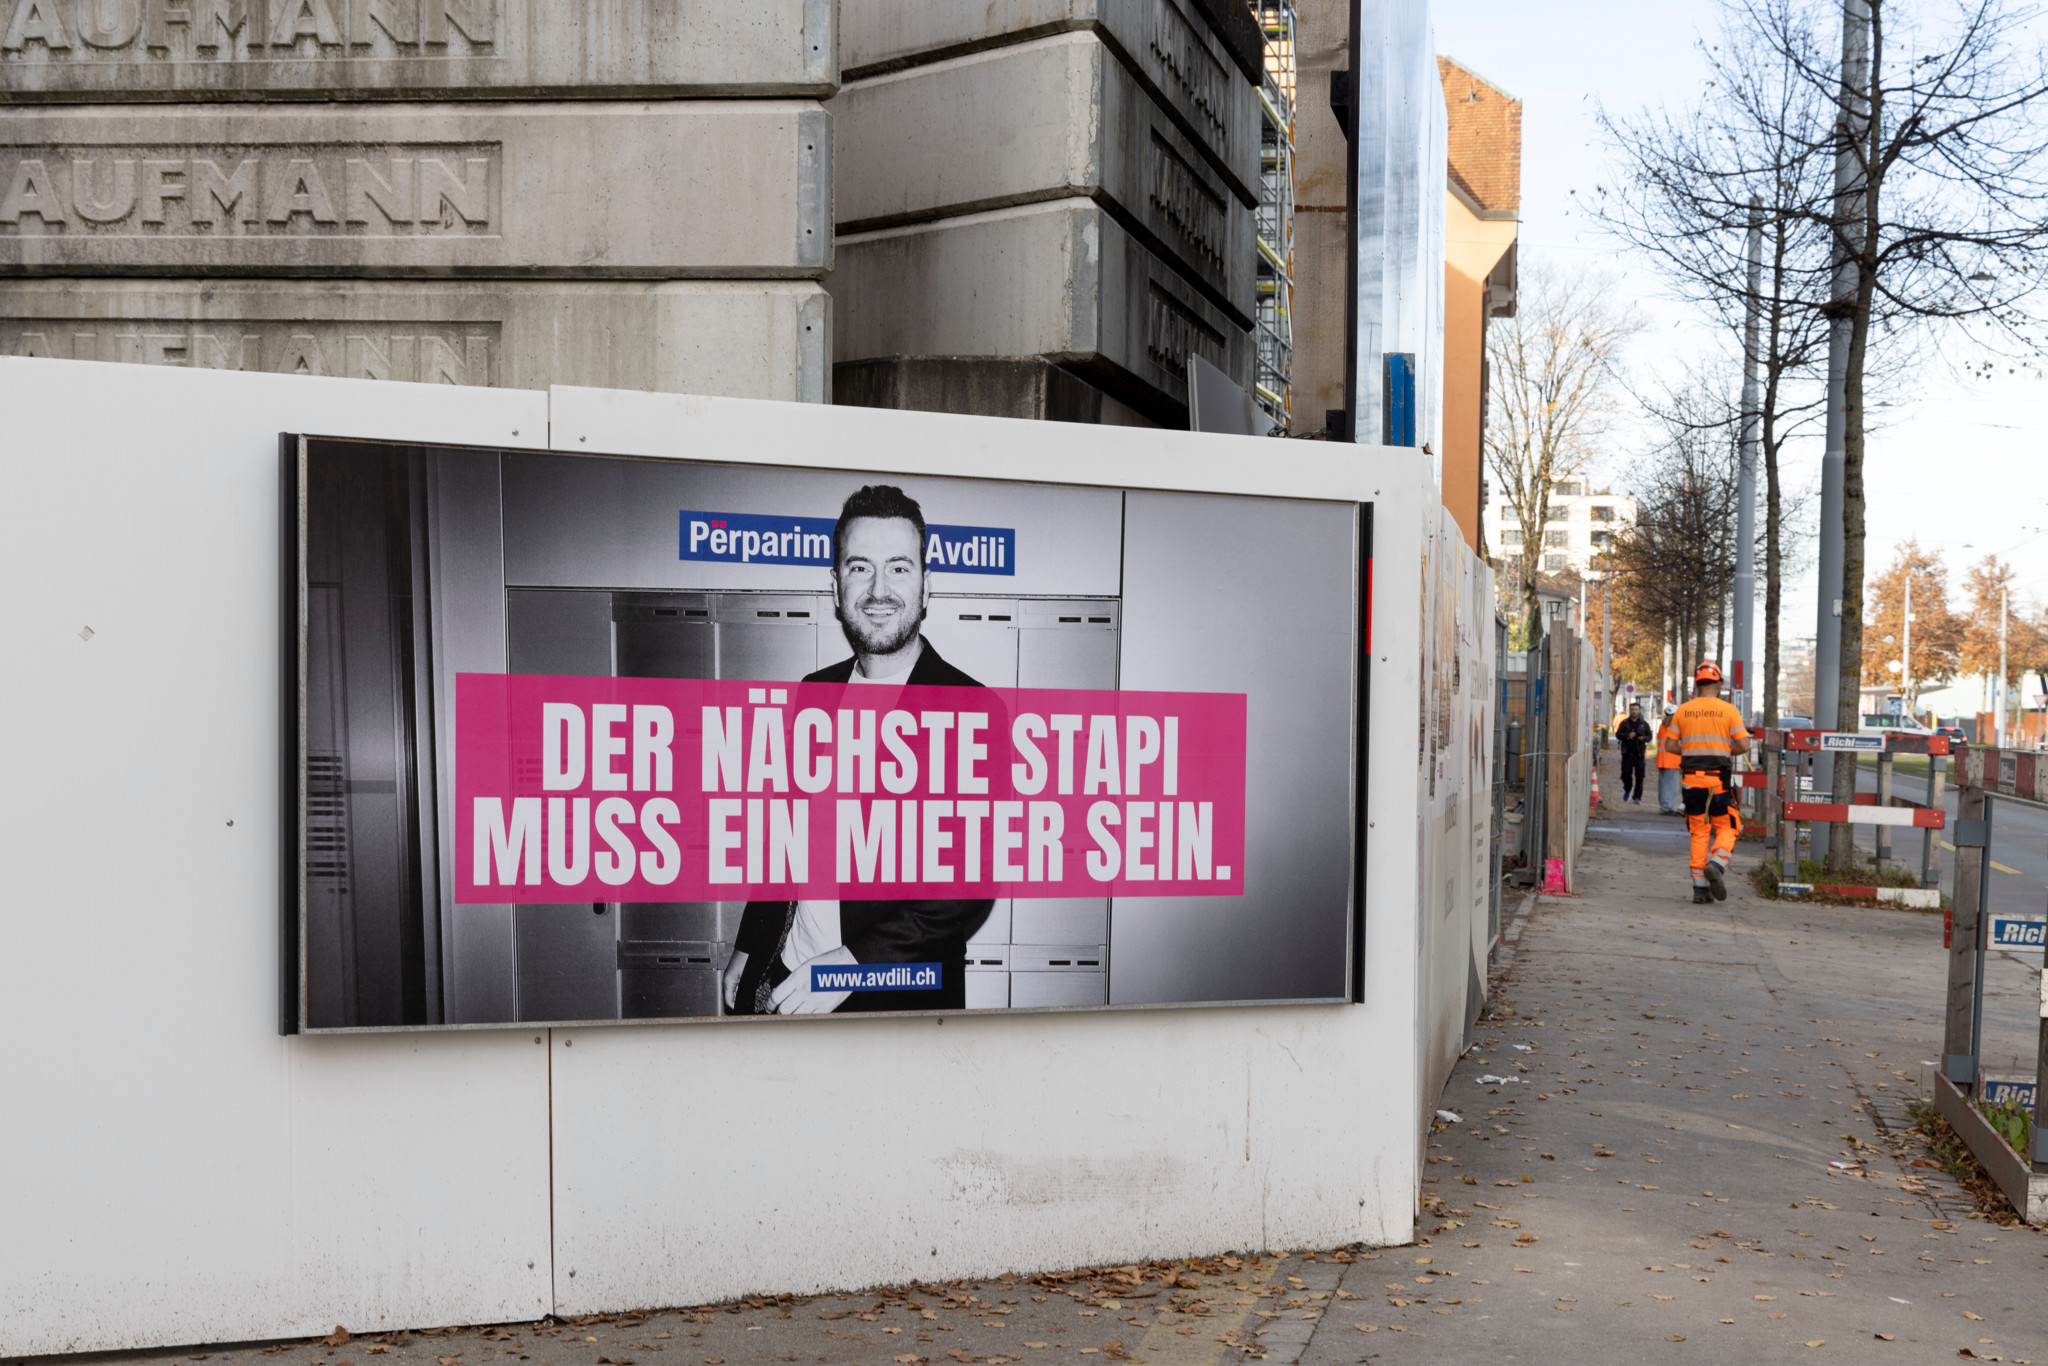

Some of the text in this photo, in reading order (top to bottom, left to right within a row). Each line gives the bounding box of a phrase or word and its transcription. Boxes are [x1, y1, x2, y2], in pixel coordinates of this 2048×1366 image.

[690, 520, 1005, 568] Përparim Avdili
[1684, 709, 1724, 719] Implenia
[543, 688, 1179, 796] DER NÄCHSTE STAPI
[474, 797, 1231, 886] MUSS EIN MIETER SEIN.
[817, 967, 936, 988] www.avdili.ch
